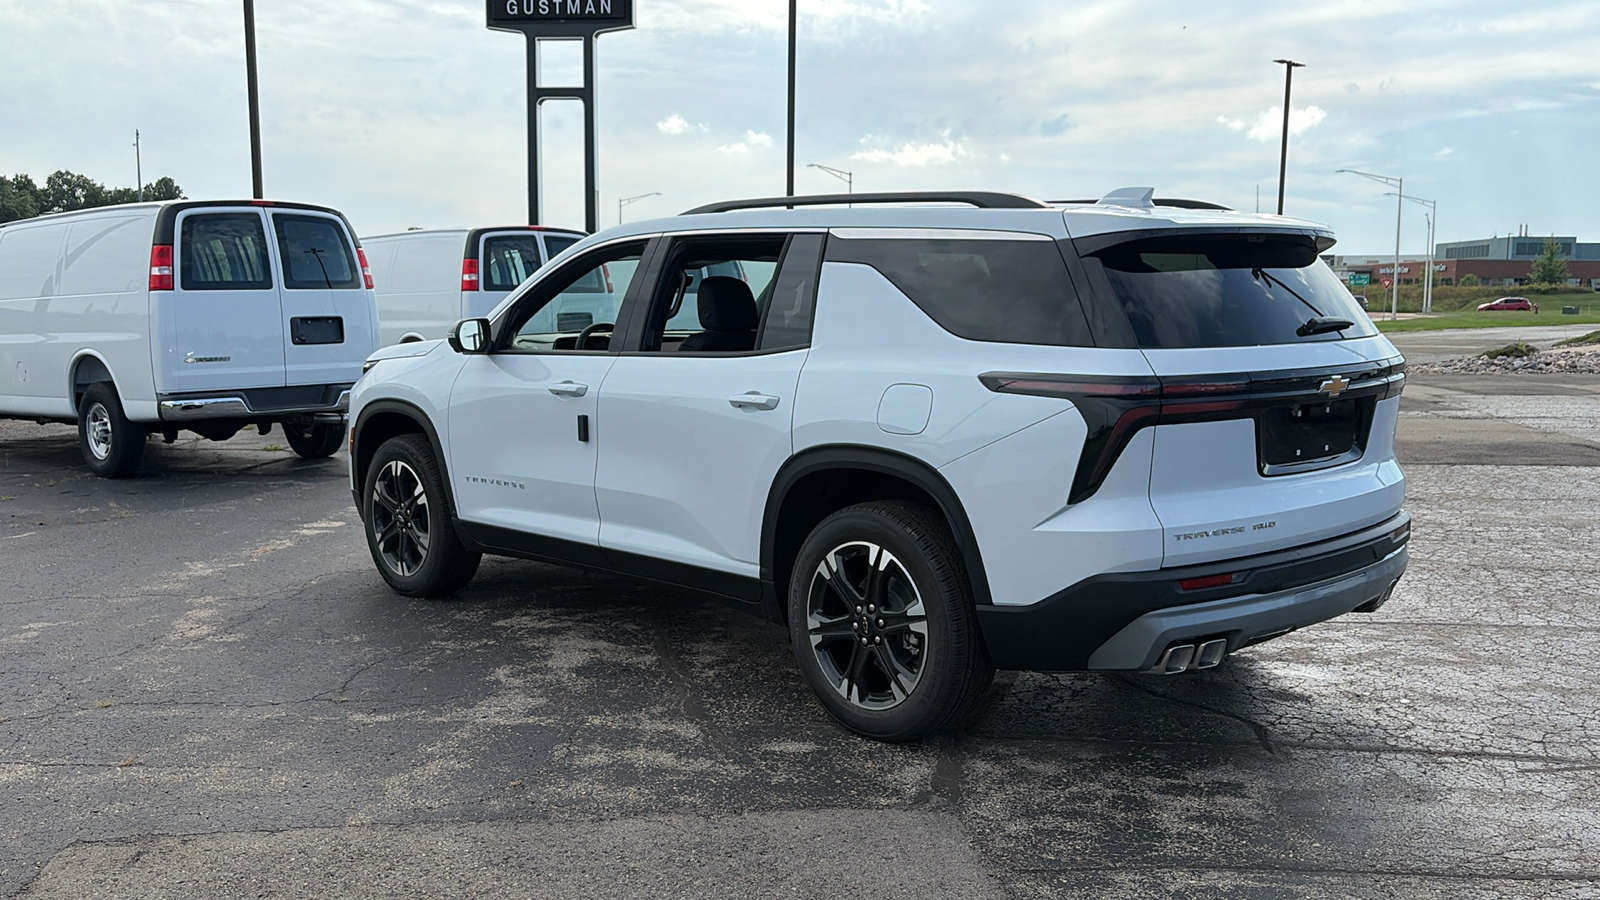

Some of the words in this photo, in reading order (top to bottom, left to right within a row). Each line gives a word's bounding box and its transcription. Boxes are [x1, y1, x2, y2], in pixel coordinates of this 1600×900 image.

[506, 0, 612, 15] GUSTMAN
[465, 476, 526, 490] TRAVERSE
[1173, 525, 1246, 541] TRAVERSE
